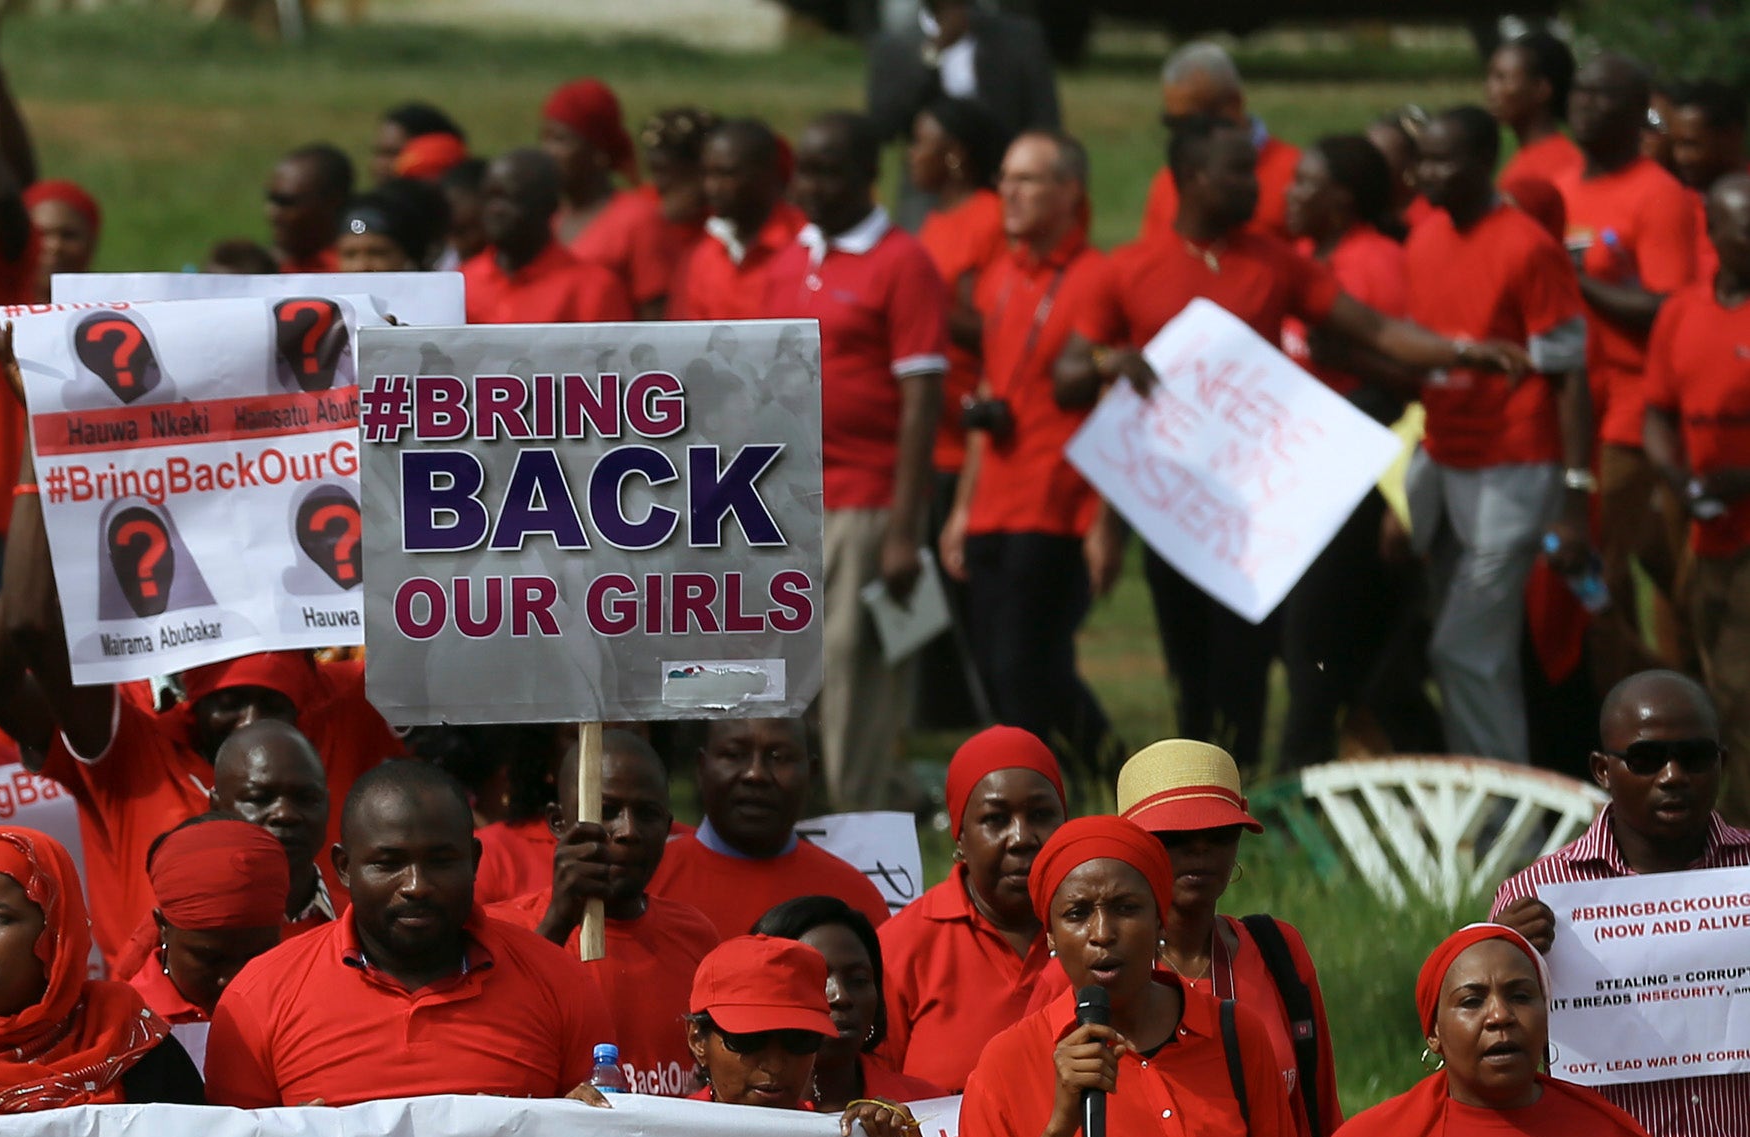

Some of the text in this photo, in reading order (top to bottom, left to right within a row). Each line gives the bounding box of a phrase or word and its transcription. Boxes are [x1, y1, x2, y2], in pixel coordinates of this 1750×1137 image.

[360, 371, 686, 442] #BRING
[67, 416, 138, 447] Hauwa
[150, 407, 210, 438] Nkeki
[399, 443, 788, 553] BACK
[394, 569, 814, 641] OUR GIRLS
[160, 620, 223, 650] Abubakar
[303, 604, 360, 629] Hauwa
[1594, 923, 1645, 943] (NOW
[1652, 920, 1691, 936] AND
[1573, 993, 1632, 1010] BREADS
[1595, 974, 1668, 992] STEALING
[1606, 1059, 1643, 1073] LEAD
[1647, 1056, 1678, 1068] WAR
[1682, 1053, 1702, 1065] ON
